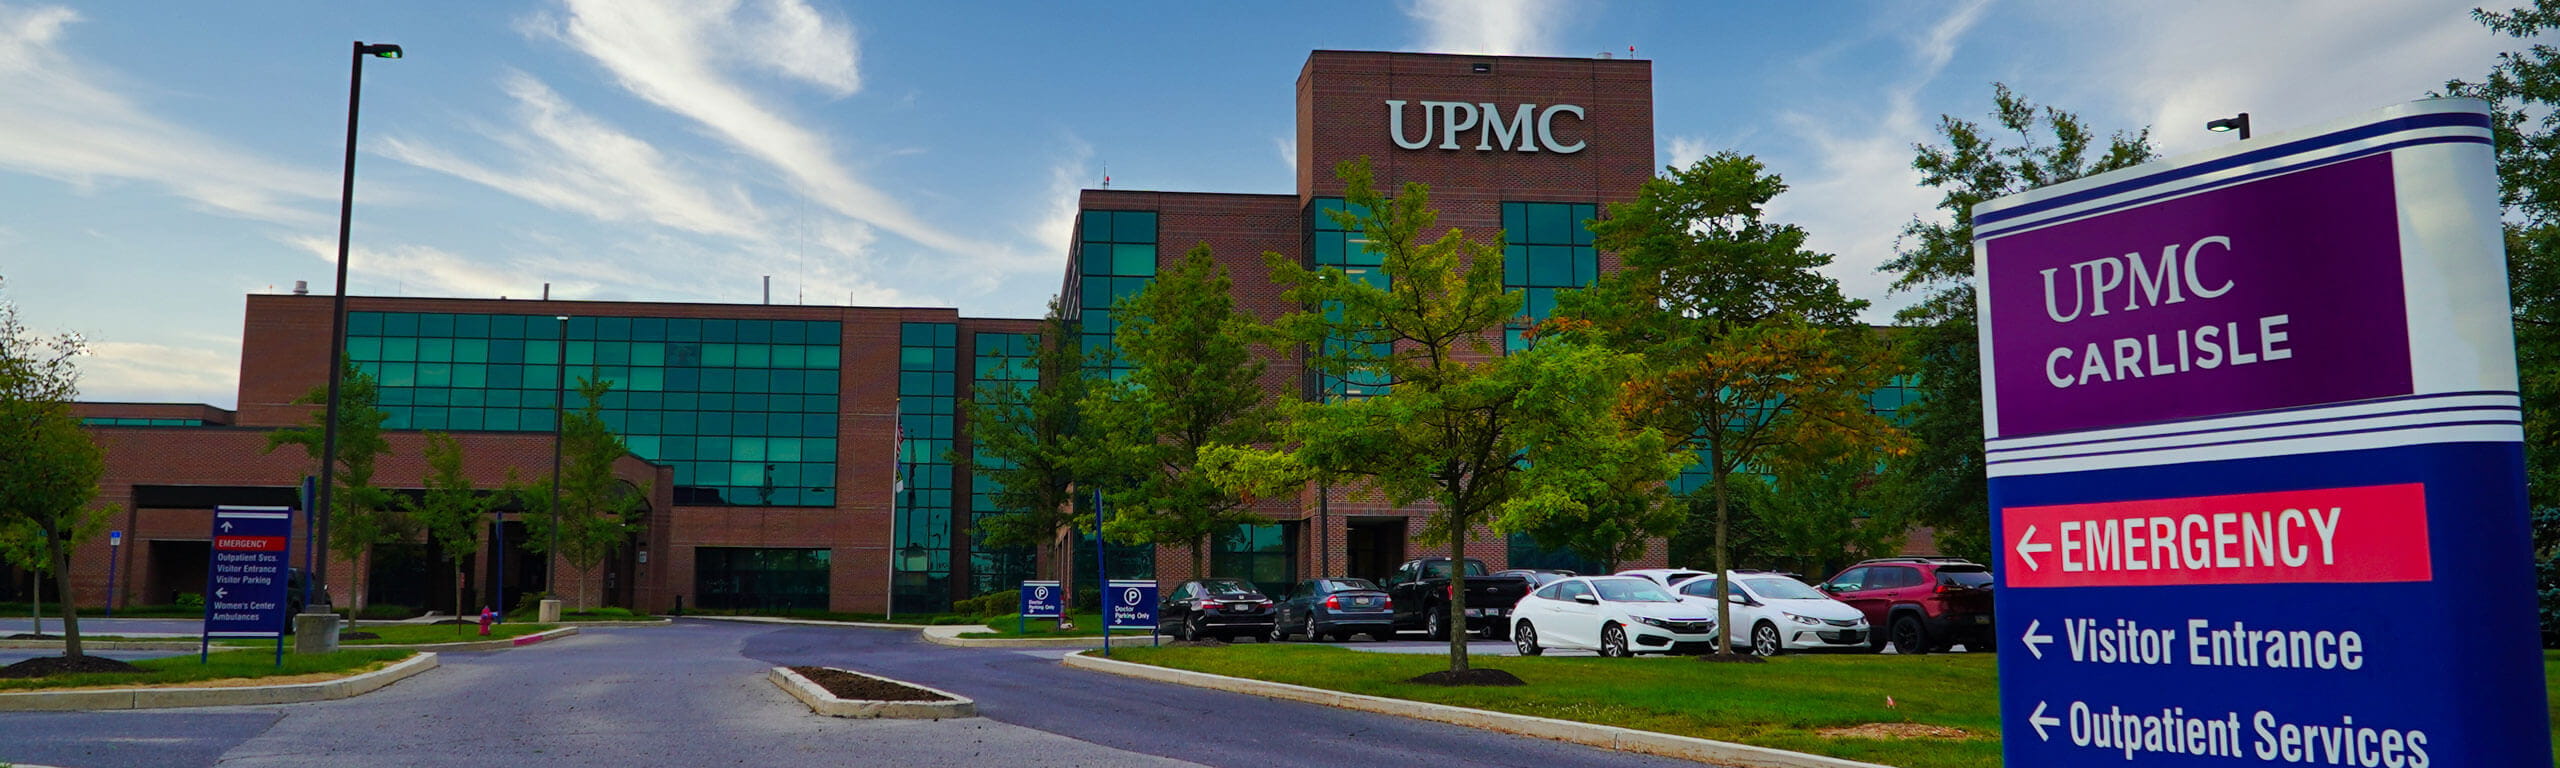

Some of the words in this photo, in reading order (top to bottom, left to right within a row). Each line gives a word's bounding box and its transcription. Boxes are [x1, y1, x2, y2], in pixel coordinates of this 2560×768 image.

[1385, 99, 1586, 154] UPMC
[2039, 235, 2235, 323] UPMC
[2046, 314, 2293, 389] CARLISLE
[218, 539, 268, 548] EMERGENCY
[2060, 507, 2342, 572] EMERGENCY
[217, 553, 257, 563] Outpatient
[258, 553, 279, 562] Svcs.
[217, 564, 243, 573] Visitor
[243, 565, 277, 573] Entrance
[216, 575, 241, 584] Visitor
[242, 576, 272, 586] Parking
[214, 602, 249, 610] Women's
[250, 602, 276, 610] Center
[213, 613, 260, 621] Ambulances
[1115, 612, 1136, 620] Parking
[1137, 612, 1150, 620] Only
[2064, 618, 2176, 665] Visitor
[2187, 618, 2364, 671] Entrance
[2070, 701, 2242, 761] Outpatient
[2253, 710, 2430, 768] Services
